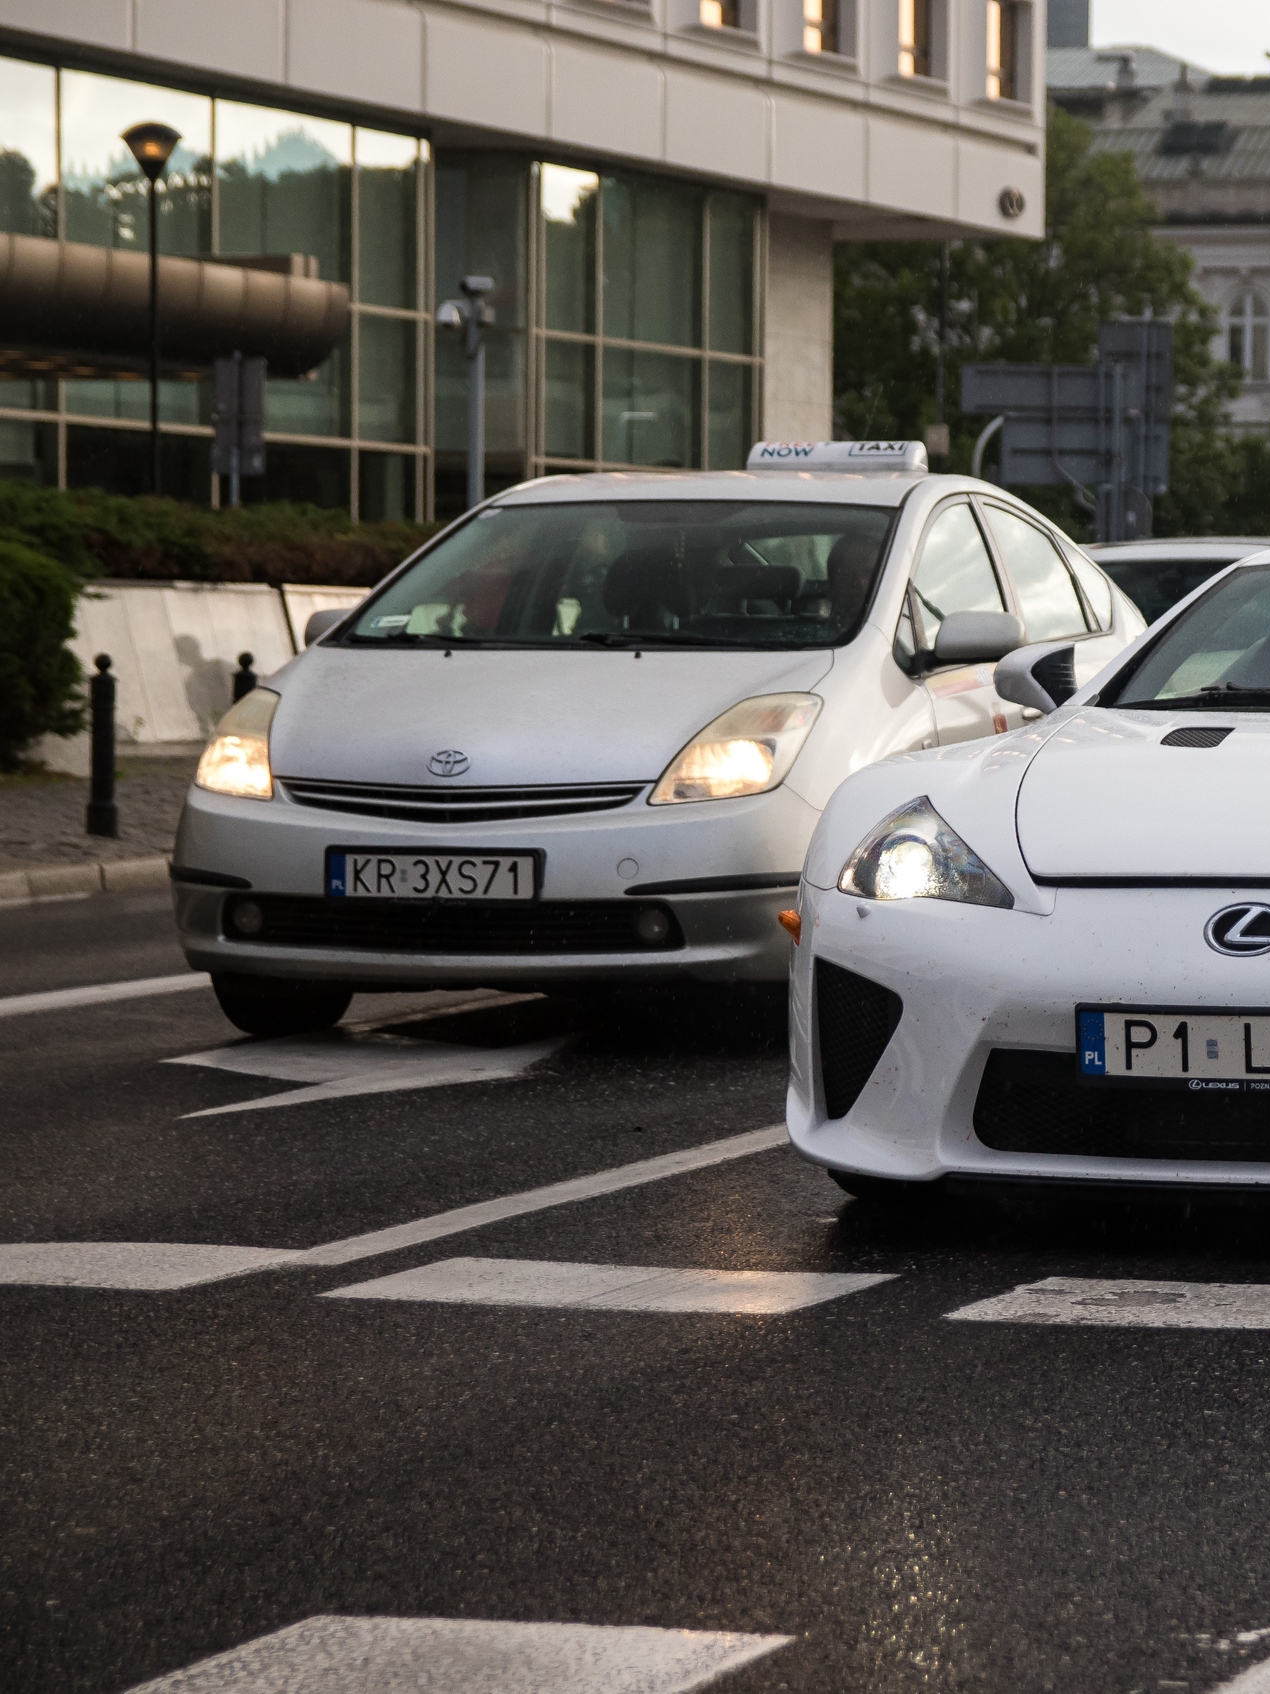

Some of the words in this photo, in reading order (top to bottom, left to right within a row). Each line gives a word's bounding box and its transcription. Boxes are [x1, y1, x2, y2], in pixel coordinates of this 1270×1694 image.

[761, 446, 814, 457] NOW
[859, 442, 905, 451] TAXI
[353, 858, 397, 894] KR
[412, 859, 519, 895] 3XS71
[331, 879, 344, 890] PL
[1124, 1019, 1190, 1073] P1
[1085, 1051, 1102, 1066] PL
